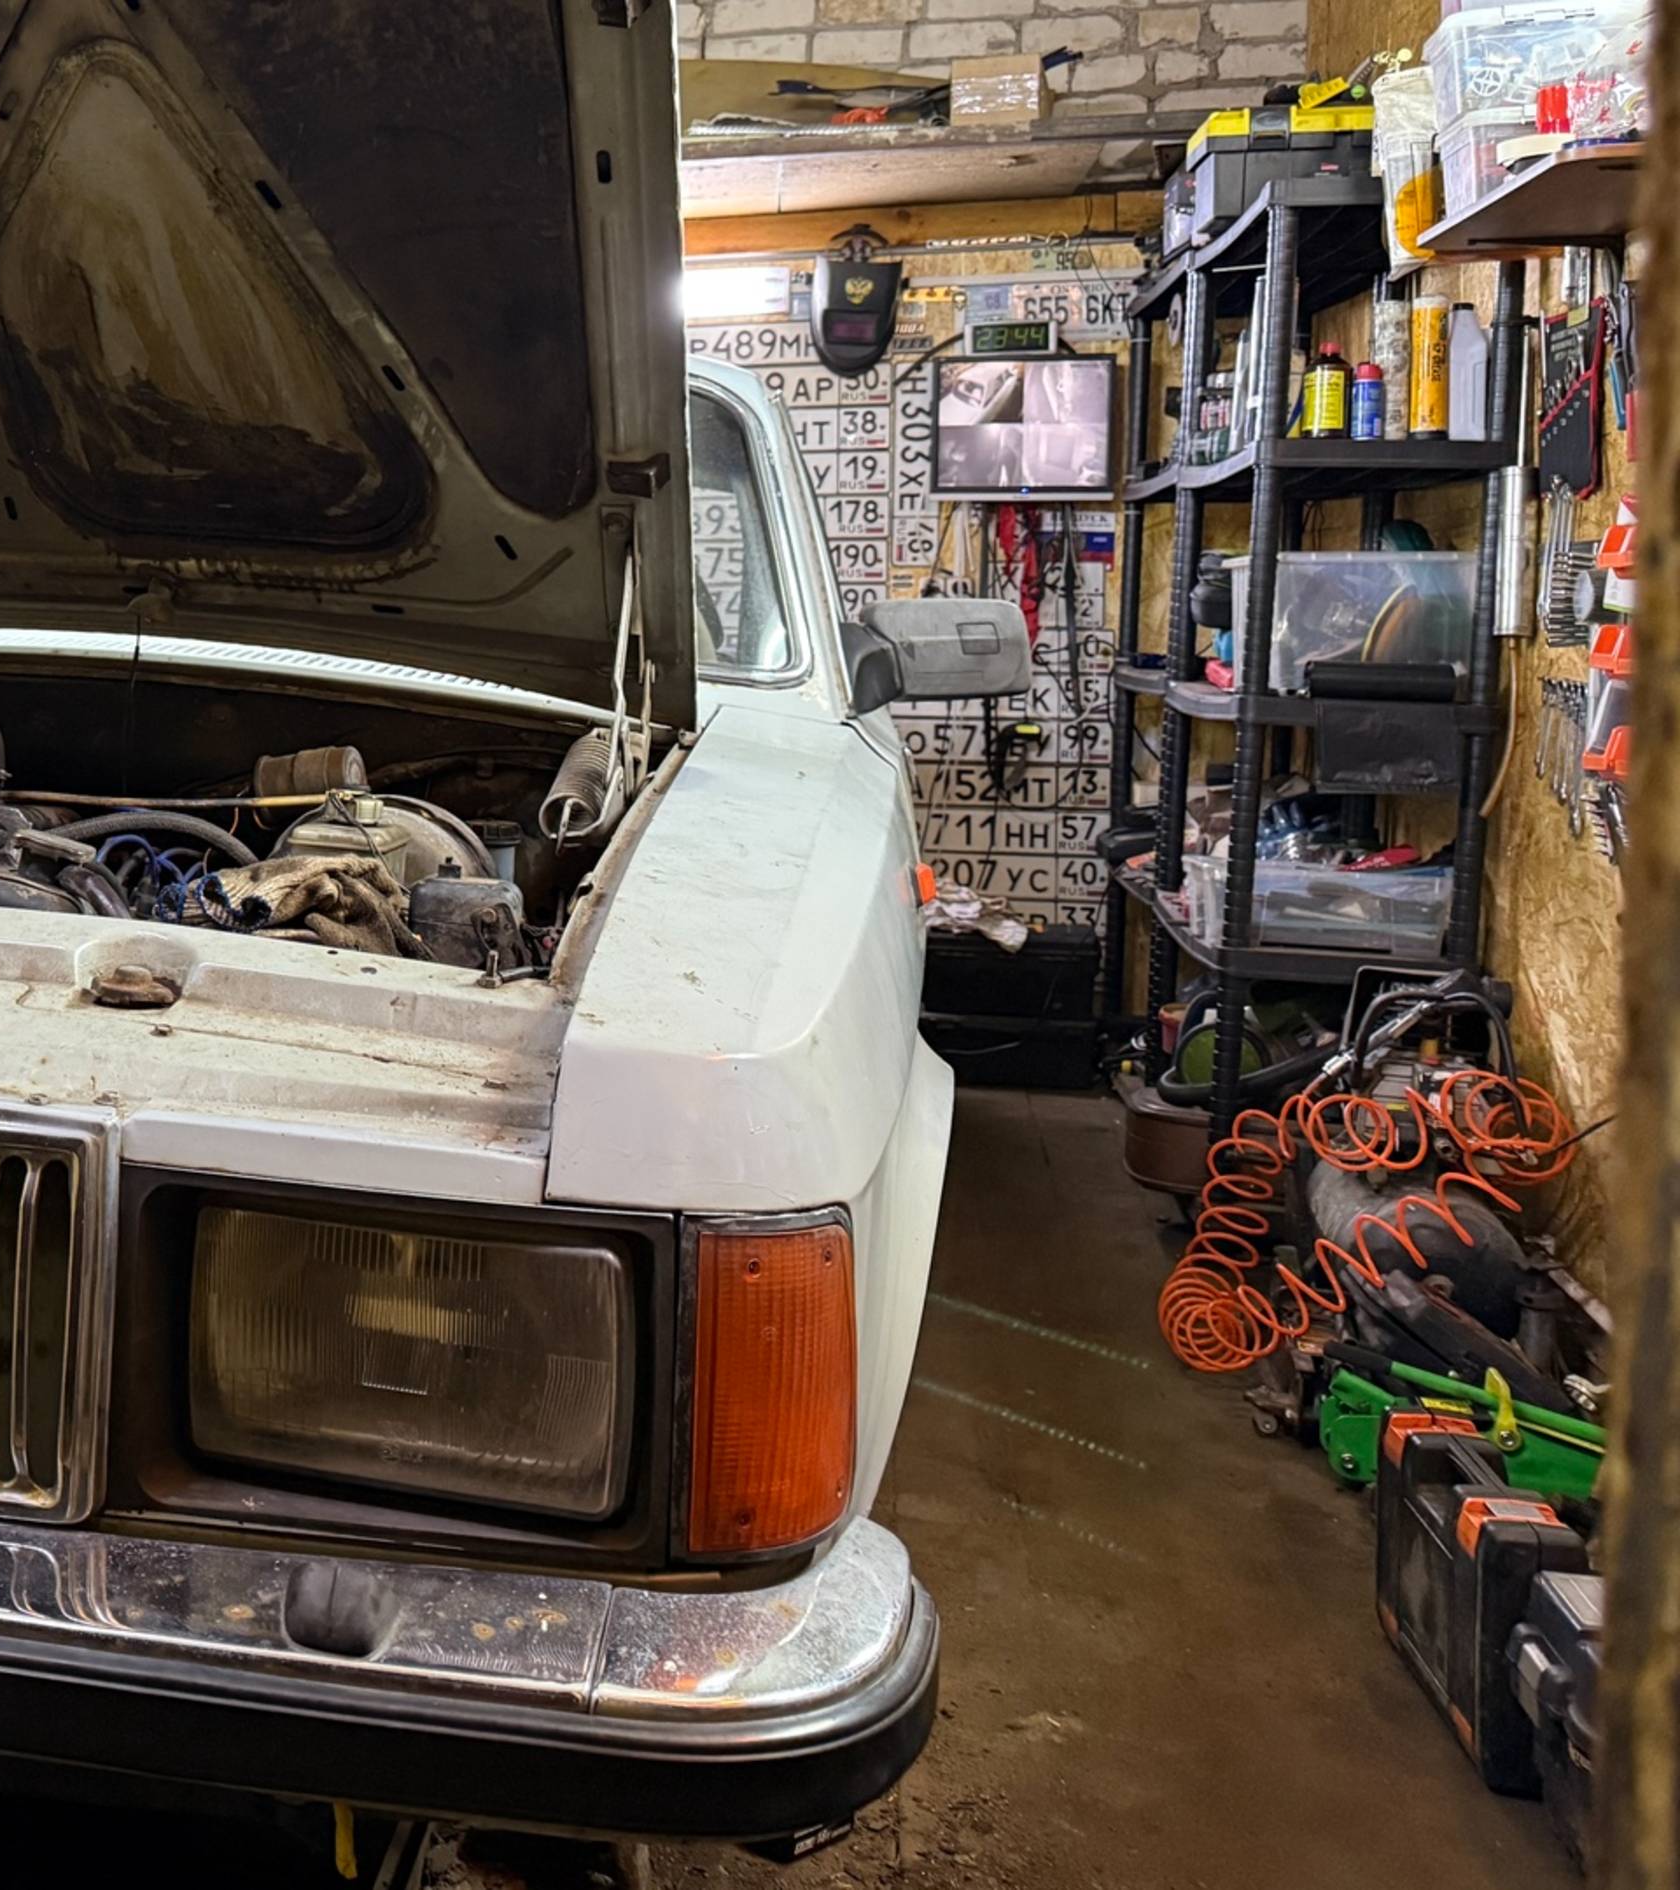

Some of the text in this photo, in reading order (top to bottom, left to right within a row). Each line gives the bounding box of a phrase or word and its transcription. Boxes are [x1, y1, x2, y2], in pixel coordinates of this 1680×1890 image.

[843, 411, 877, 434] 38
[845, 456, 878, 480] 19
[829, 500, 879, 524] 178
[1064, 769, 1098, 794] 13
[1062, 816, 1097, 840] 57
[1062, 861, 1097, 885] 40
